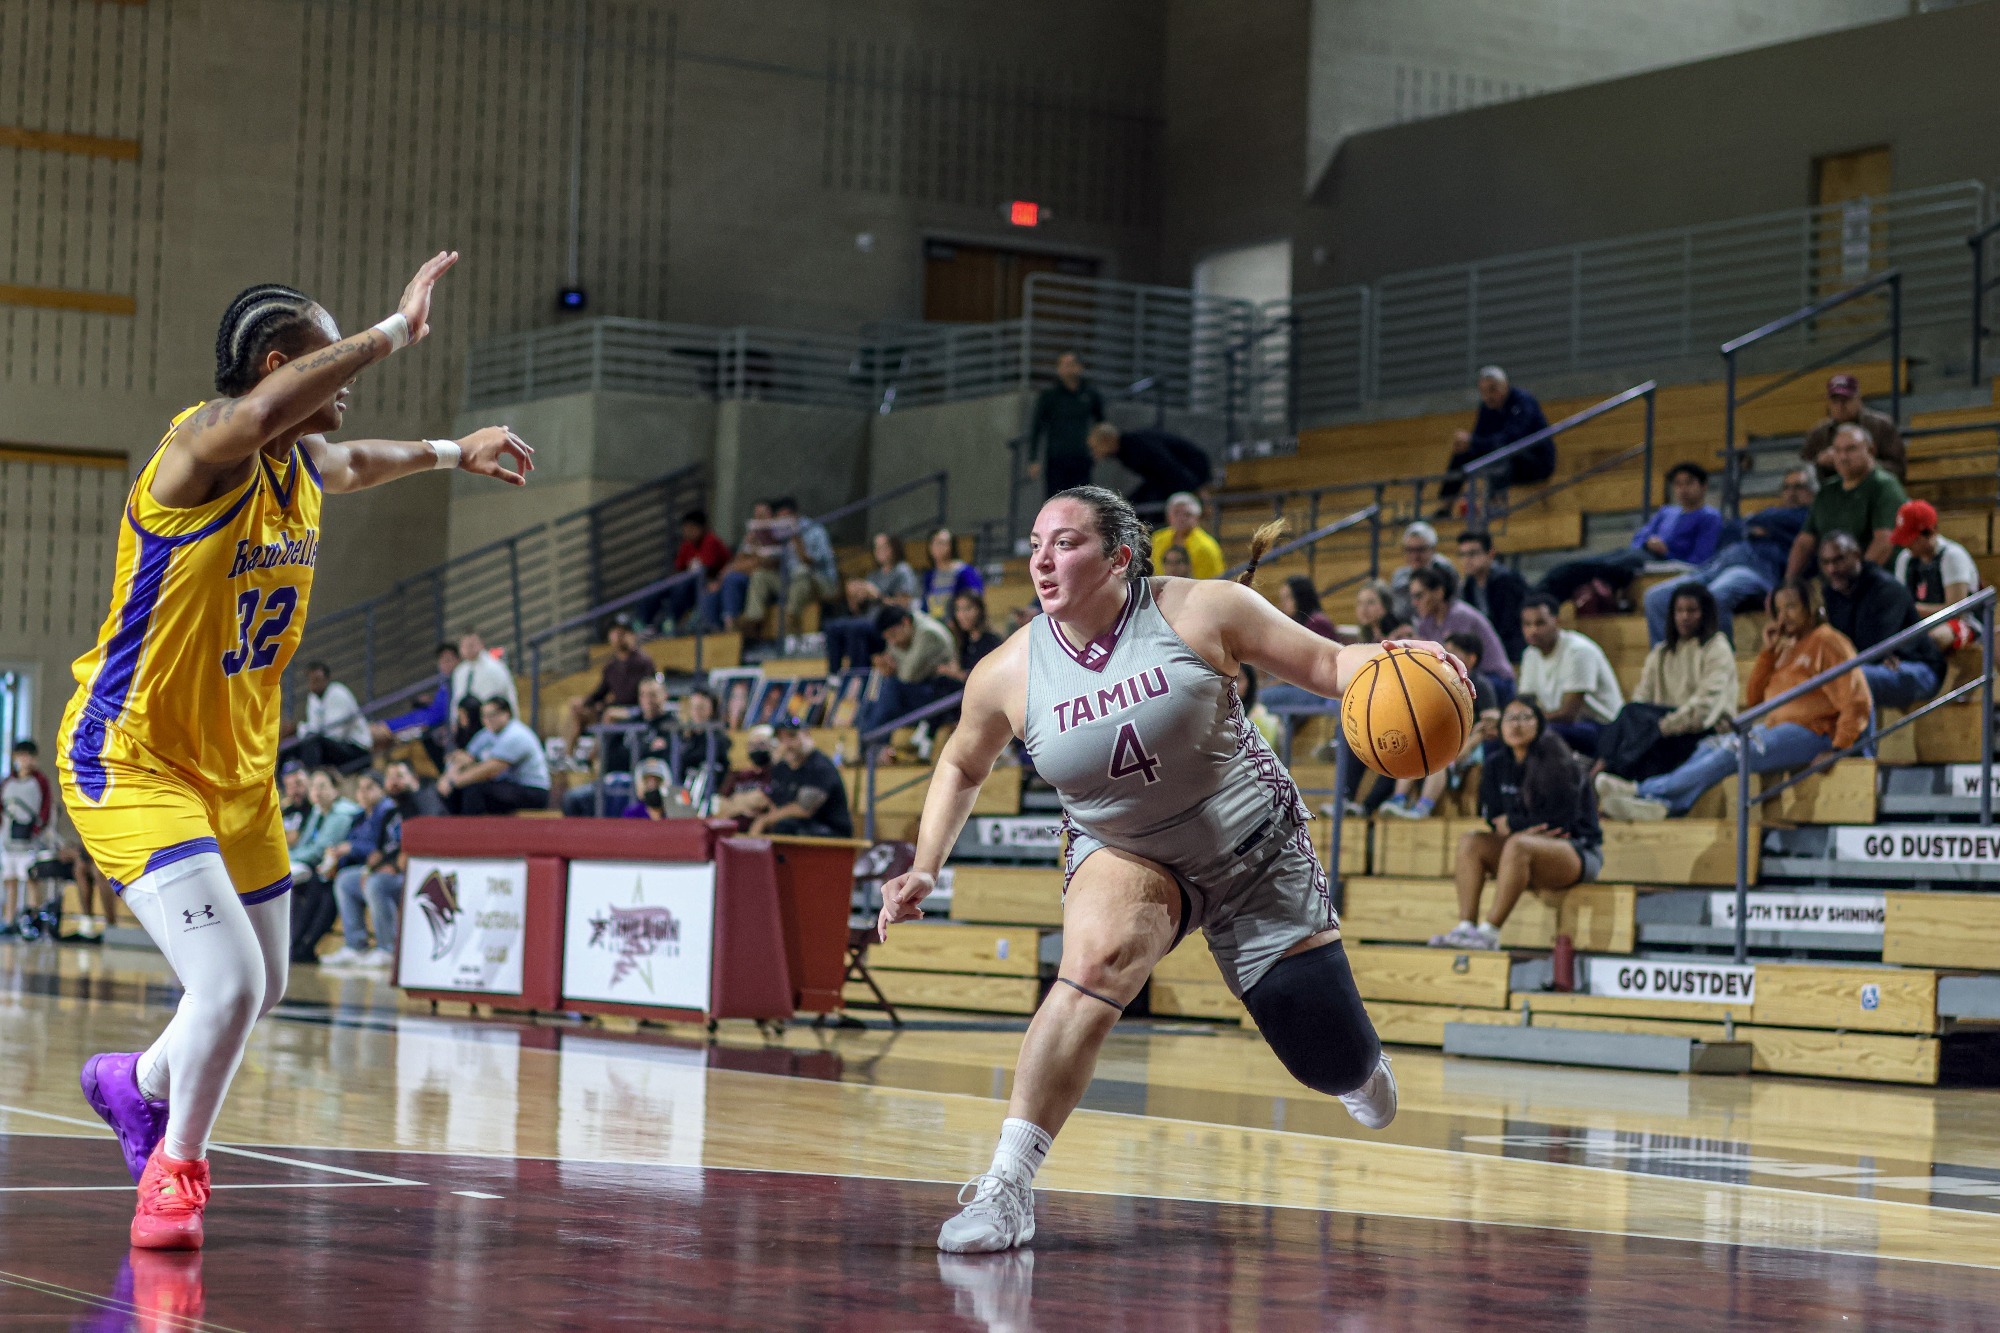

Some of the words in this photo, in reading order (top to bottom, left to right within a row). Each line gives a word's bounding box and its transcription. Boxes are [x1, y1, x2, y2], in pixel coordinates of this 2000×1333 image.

[221, 586, 298, 677] 32
[1052, 665, 1171, 735] TAMIU
[1108, 719, 1162, 786] 4
[1865, 835, 1894, 857] GO
[1901, 836, 2000, 859] DUSTDEV
[1726, 904, 1771, 920] SUTH
[1828, 906, 1885, 923] SHINING
[1618, 967, 1647, 990] GO
[1654, 969, 1753, 997] DUSTDEV
